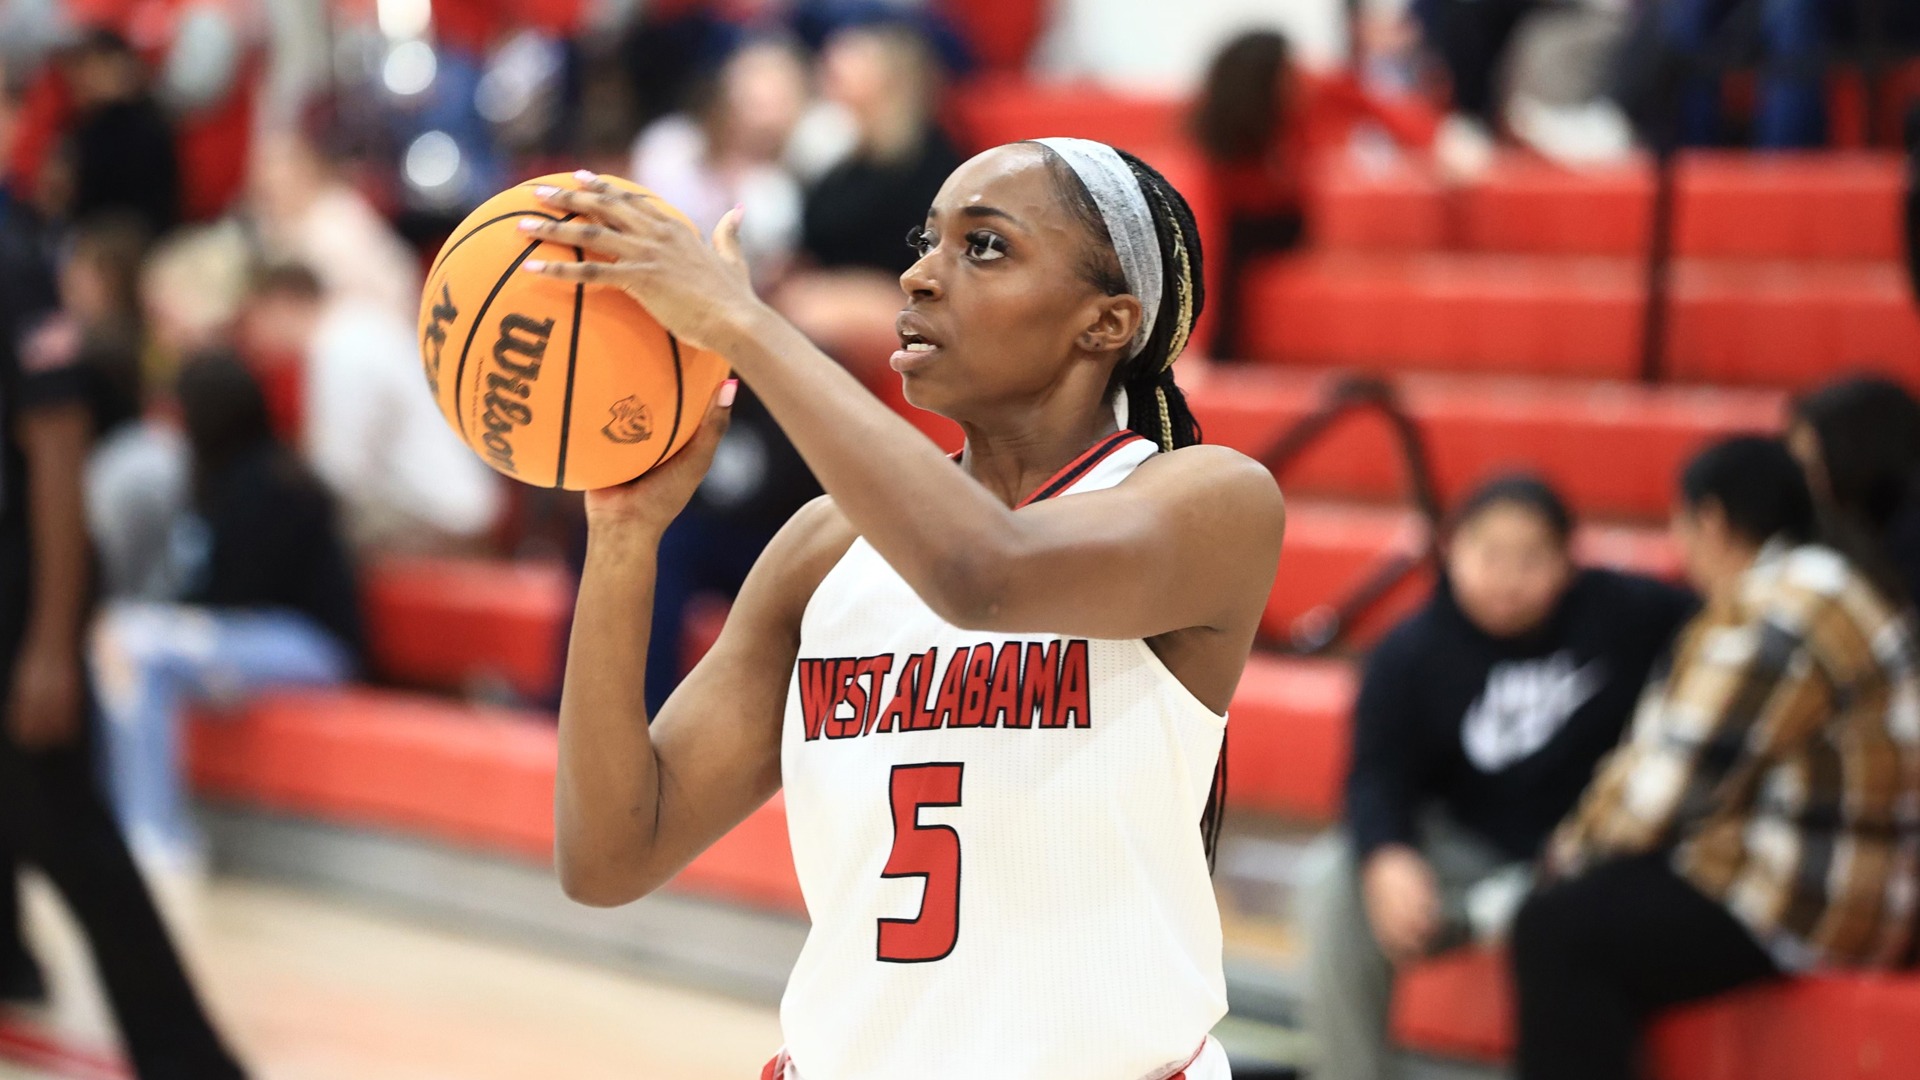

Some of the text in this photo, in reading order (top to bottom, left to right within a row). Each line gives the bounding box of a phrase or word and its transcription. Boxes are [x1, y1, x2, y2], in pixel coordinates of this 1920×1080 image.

[482, 313, 555, 474] Wilson
[798, 639, 1091, 742] WEST ALABAMA
[876, 762, 964, 963] 5
